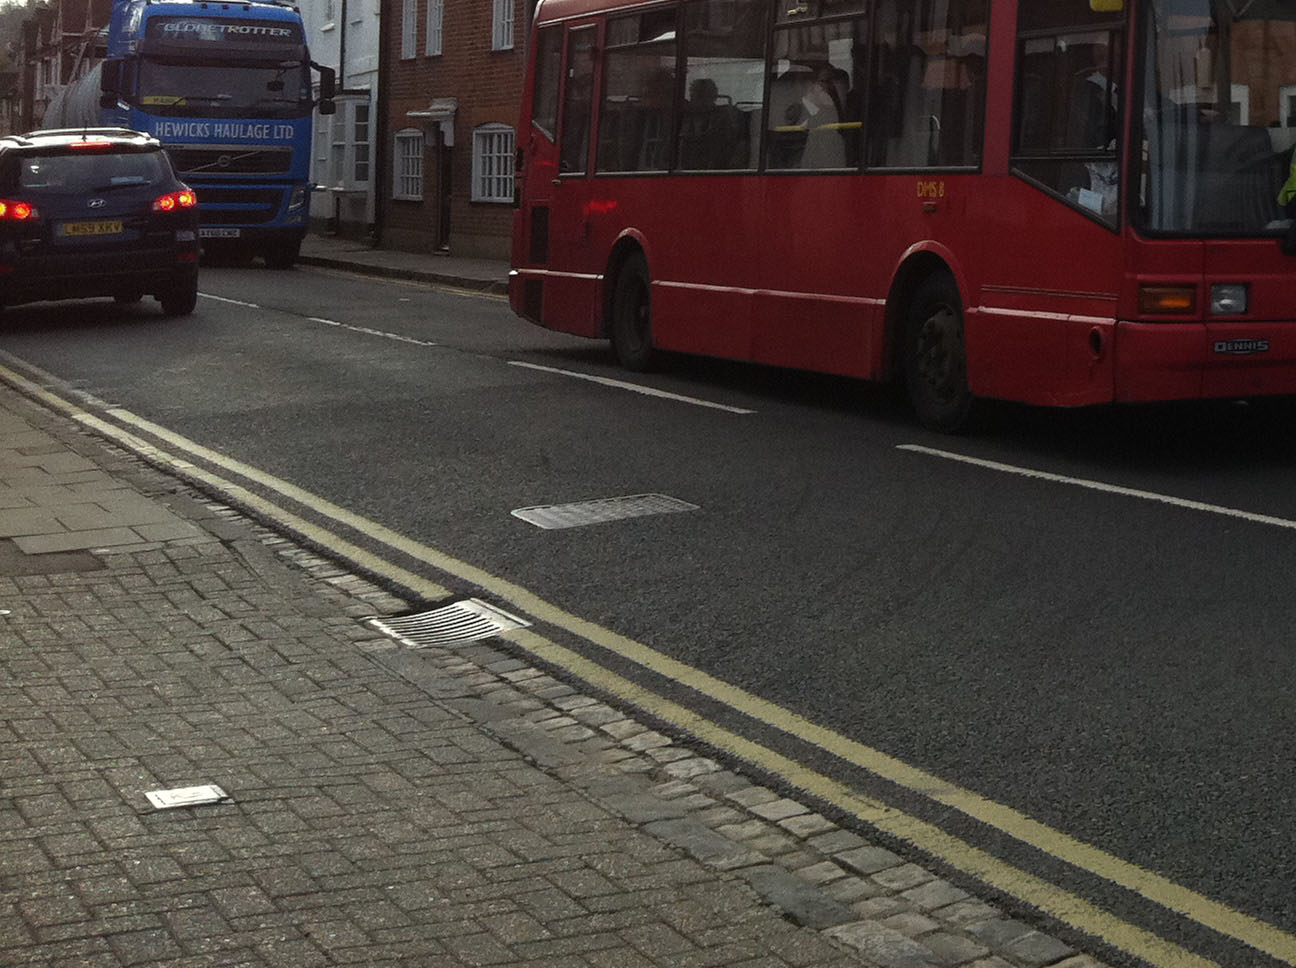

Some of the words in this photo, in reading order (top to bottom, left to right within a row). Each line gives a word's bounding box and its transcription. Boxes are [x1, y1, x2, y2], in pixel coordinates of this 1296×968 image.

[163, 22, 292, 37] GLOBETROTTER
[155, 122, 210, 138] HEWICKS
[214, 123, 271, 139] HAULAGE
[273, 125, 294, 139] LTD
[1213, 340, 1269, 353] DENNIS
